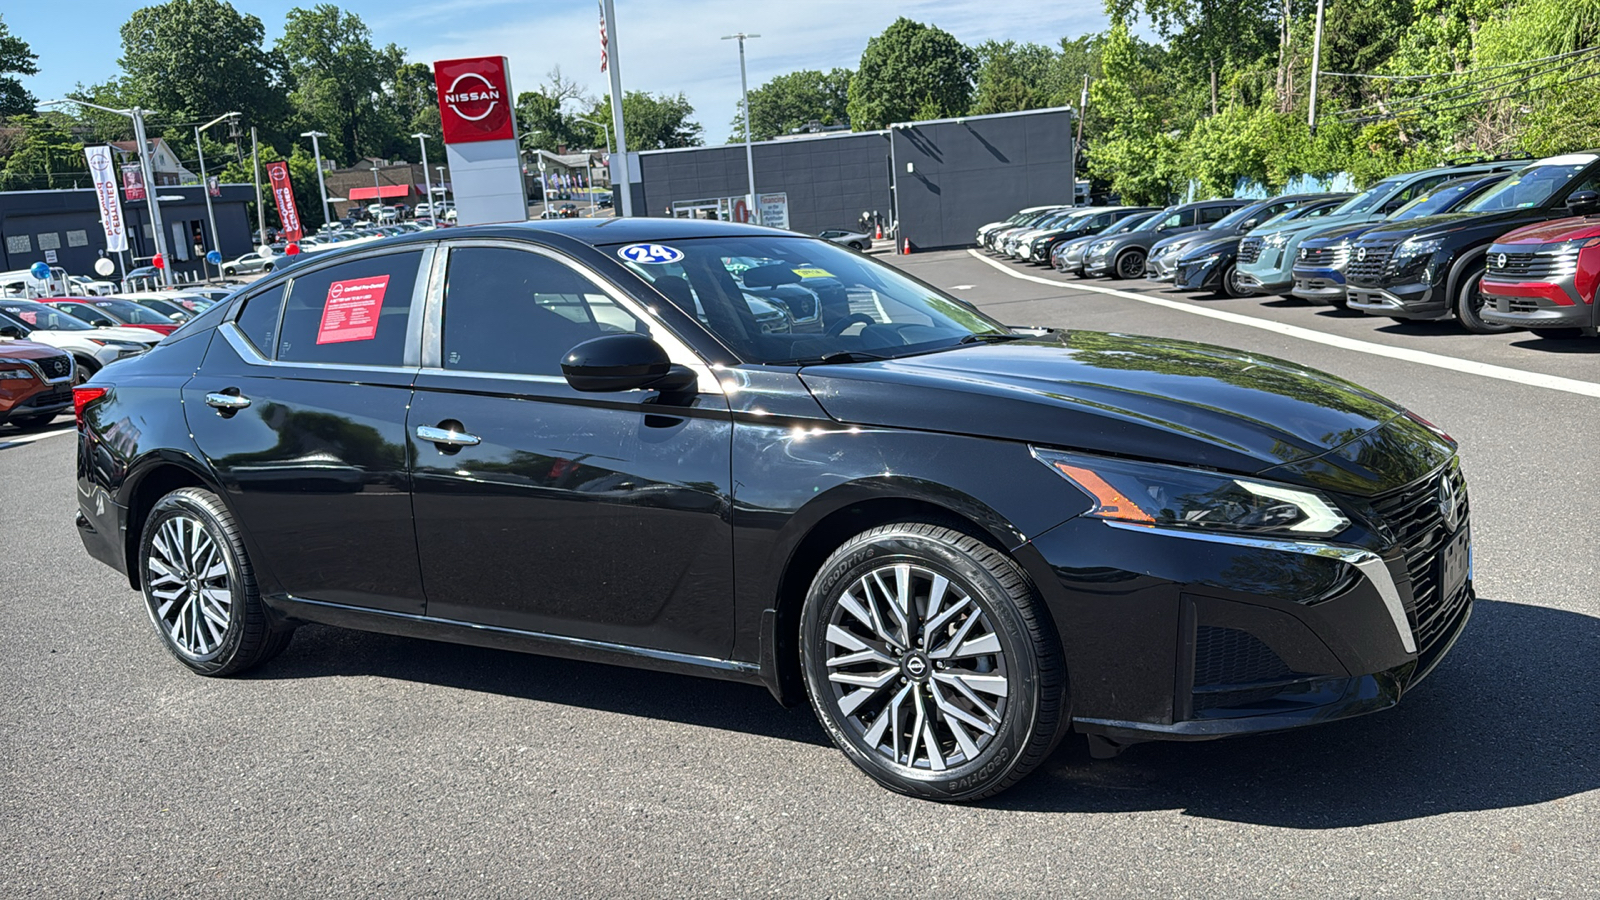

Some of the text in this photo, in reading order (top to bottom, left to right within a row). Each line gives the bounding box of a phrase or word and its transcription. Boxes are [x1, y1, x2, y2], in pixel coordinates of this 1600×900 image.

[445, 90, 499, 103] NISSAN
[628, 245, 673, 261] 24
[821, 548, 875, 596] GeoDrive
[948, 747, 1010, 791] GeoDrive
